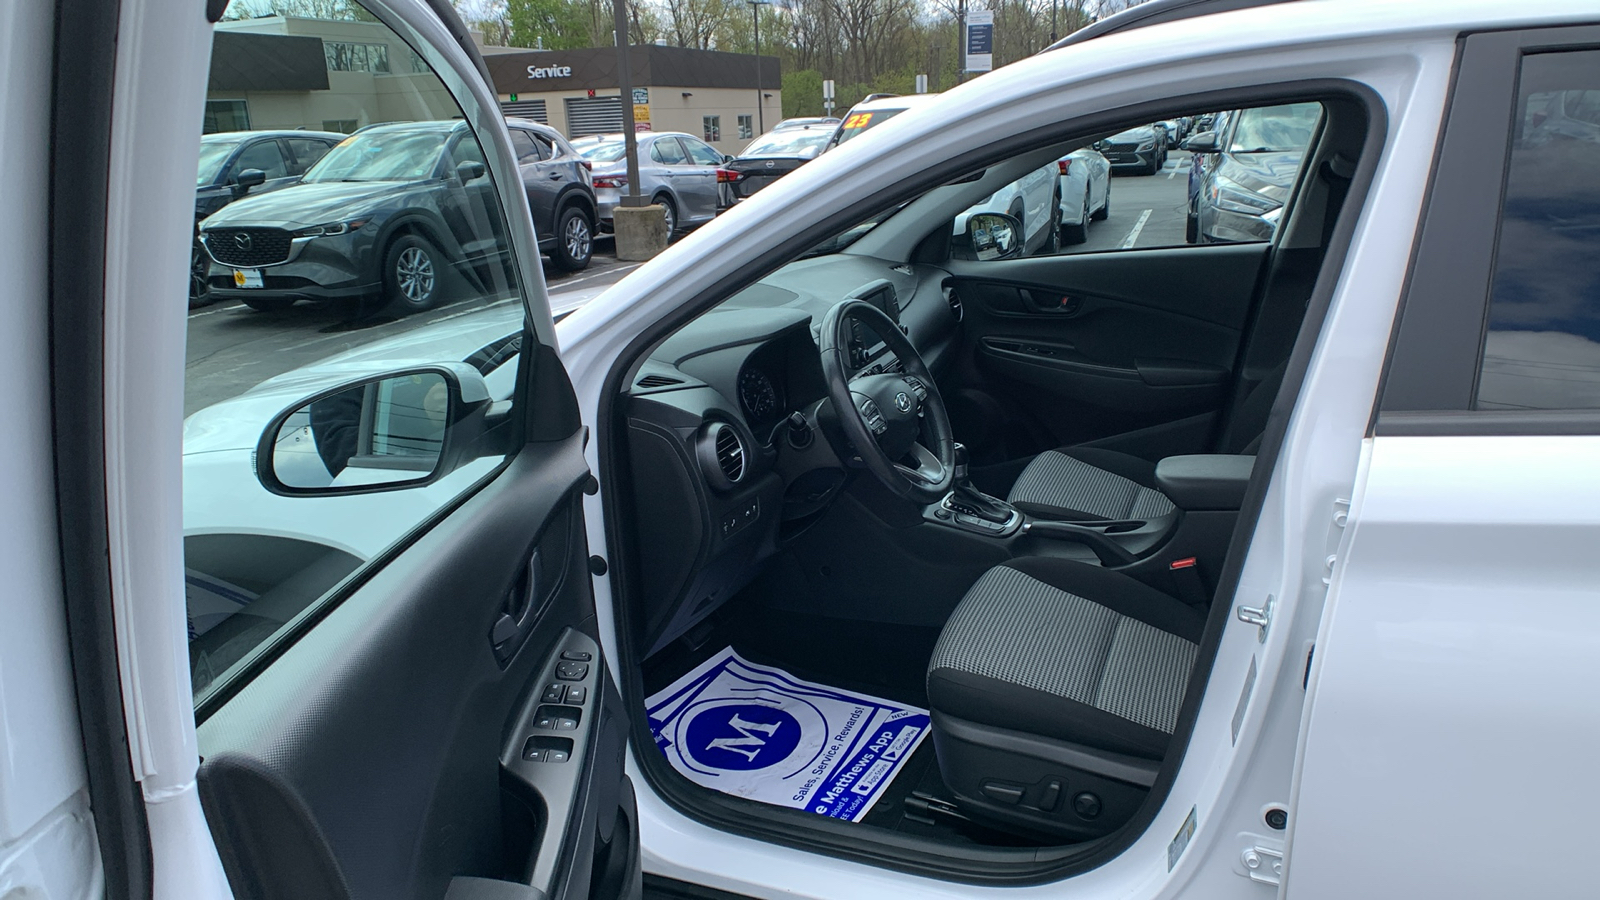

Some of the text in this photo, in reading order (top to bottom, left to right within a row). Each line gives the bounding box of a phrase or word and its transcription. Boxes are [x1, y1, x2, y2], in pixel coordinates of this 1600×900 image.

[527, 64, 571, 79] Service
[844, 113, 873, 128] 23
[891, 711, 909, 720] NEW
[705, 713, 782, 762] M
[793, 706, 865, 802] Sales, Service, Rewards!
[820, 753, 874, 804] Matthews
[869, 731, 894, 753] App
[845, 795, 864, 813] Today!
